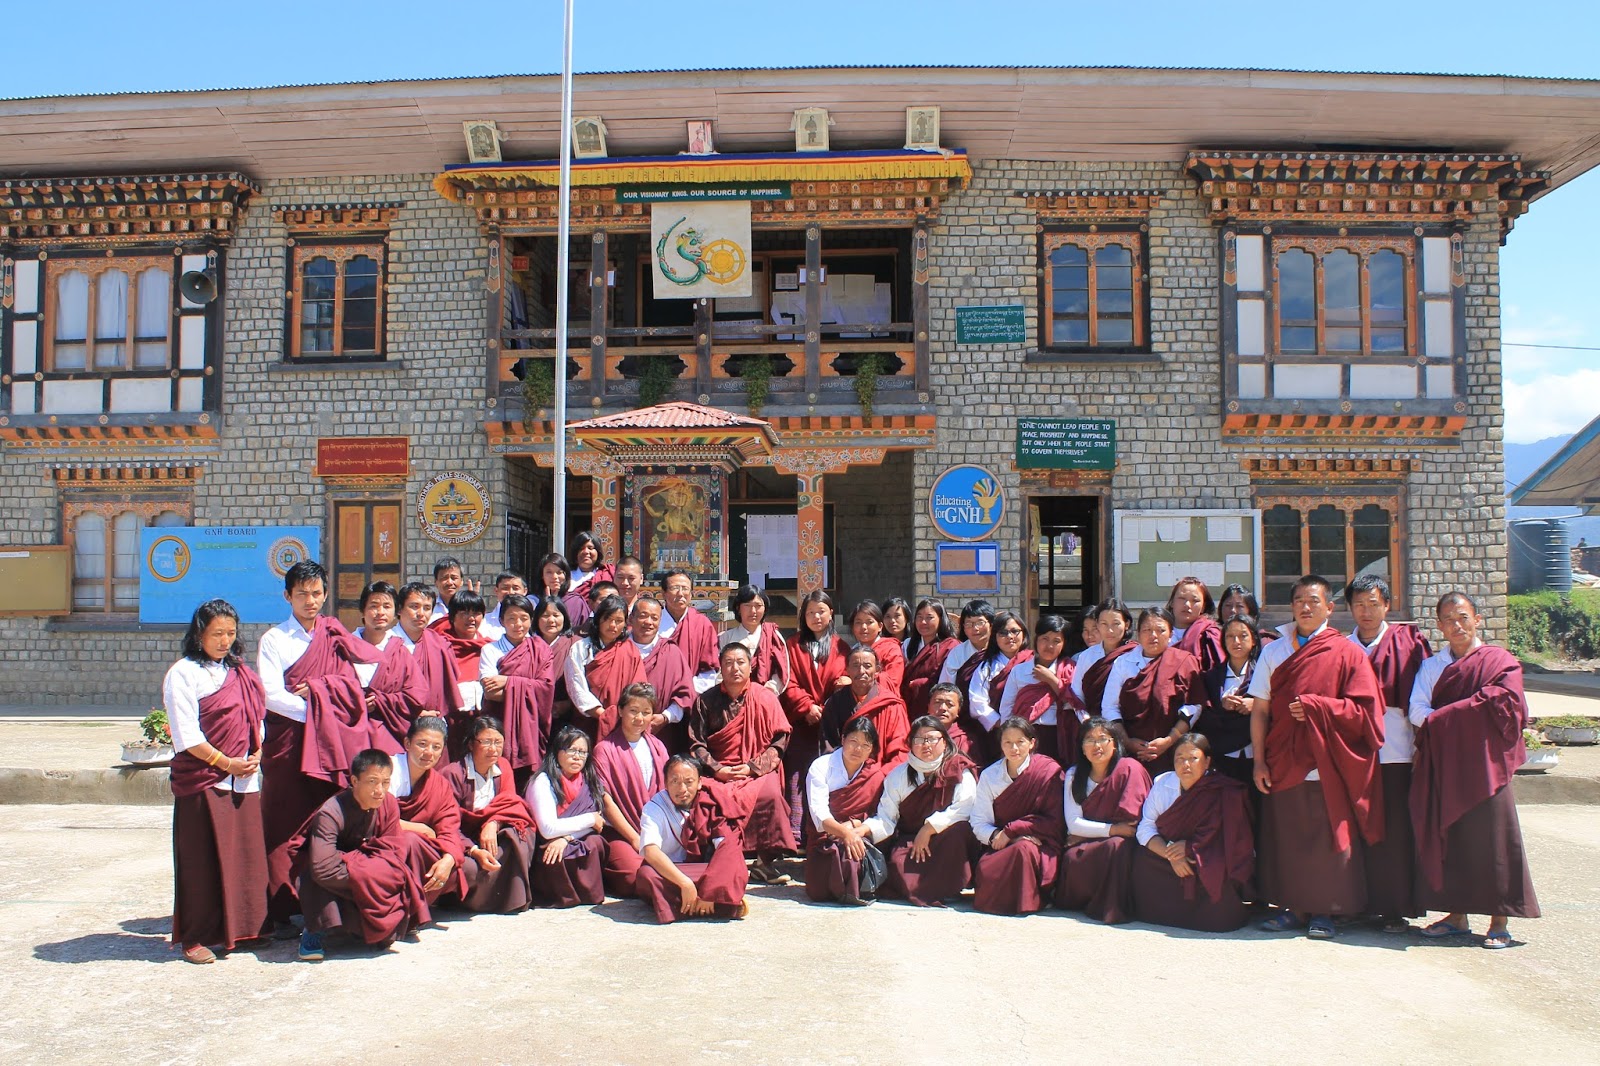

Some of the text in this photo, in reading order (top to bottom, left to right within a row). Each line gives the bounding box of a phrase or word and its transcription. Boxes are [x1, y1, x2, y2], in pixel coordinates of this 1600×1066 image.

[454, 472, 482, 489] SECONDARY
[479, 490, 490, 510] SCHOOL
[936, 495, 972, 507] Educating
[935, 507, 981, 524] for GNH
